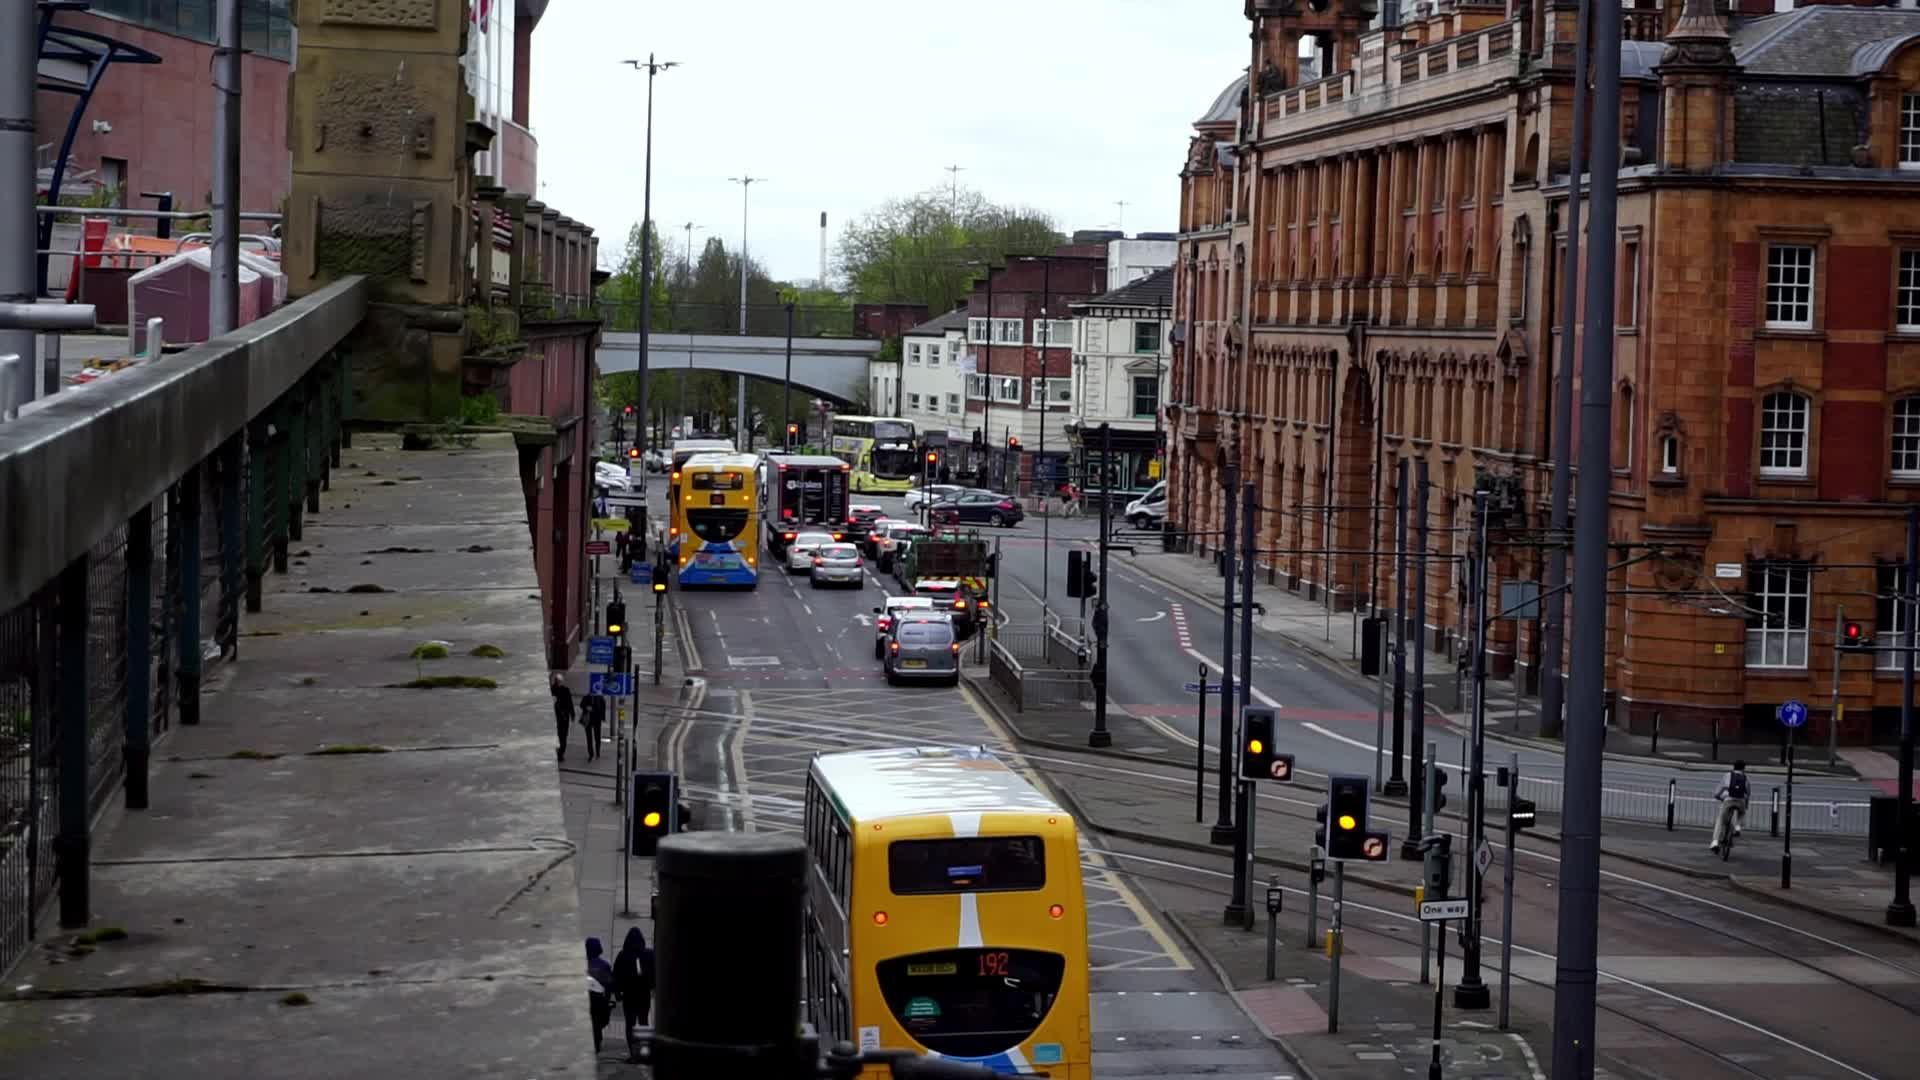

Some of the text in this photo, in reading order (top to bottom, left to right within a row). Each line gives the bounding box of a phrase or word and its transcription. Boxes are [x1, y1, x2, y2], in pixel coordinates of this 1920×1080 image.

[1423, 905, 1466, 915] One way
[978, 952, 1009, 976] 192
